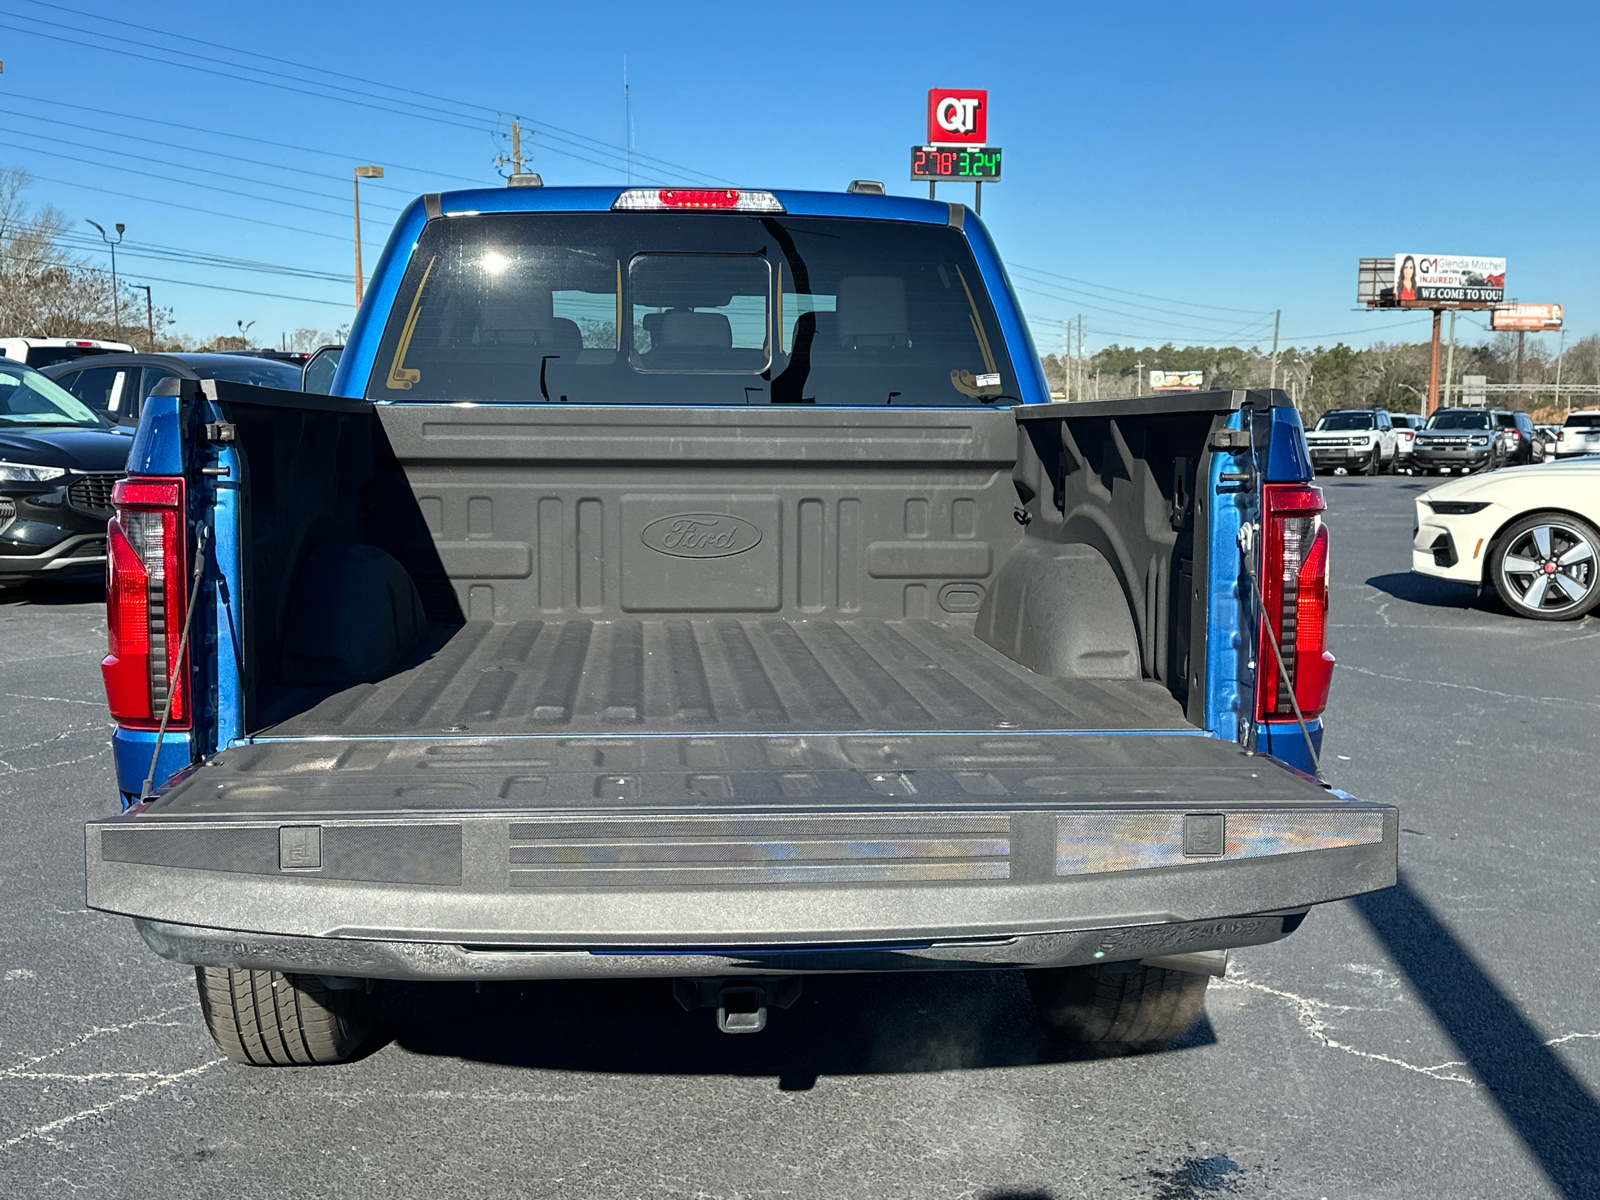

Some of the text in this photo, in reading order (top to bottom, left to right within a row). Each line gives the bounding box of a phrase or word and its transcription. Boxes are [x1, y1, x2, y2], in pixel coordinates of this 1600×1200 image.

[937, 97, 980, 134] QT
[1420, 258, 1438, 274] GM
[1439, 258, 1504, 270] Glenda Mitchell
[1419, 275, 1458, 284] INJURED?
[1421, 288, 1502, 300] WE COME TO YOU!
[663, 519, 738, 549] Ford
